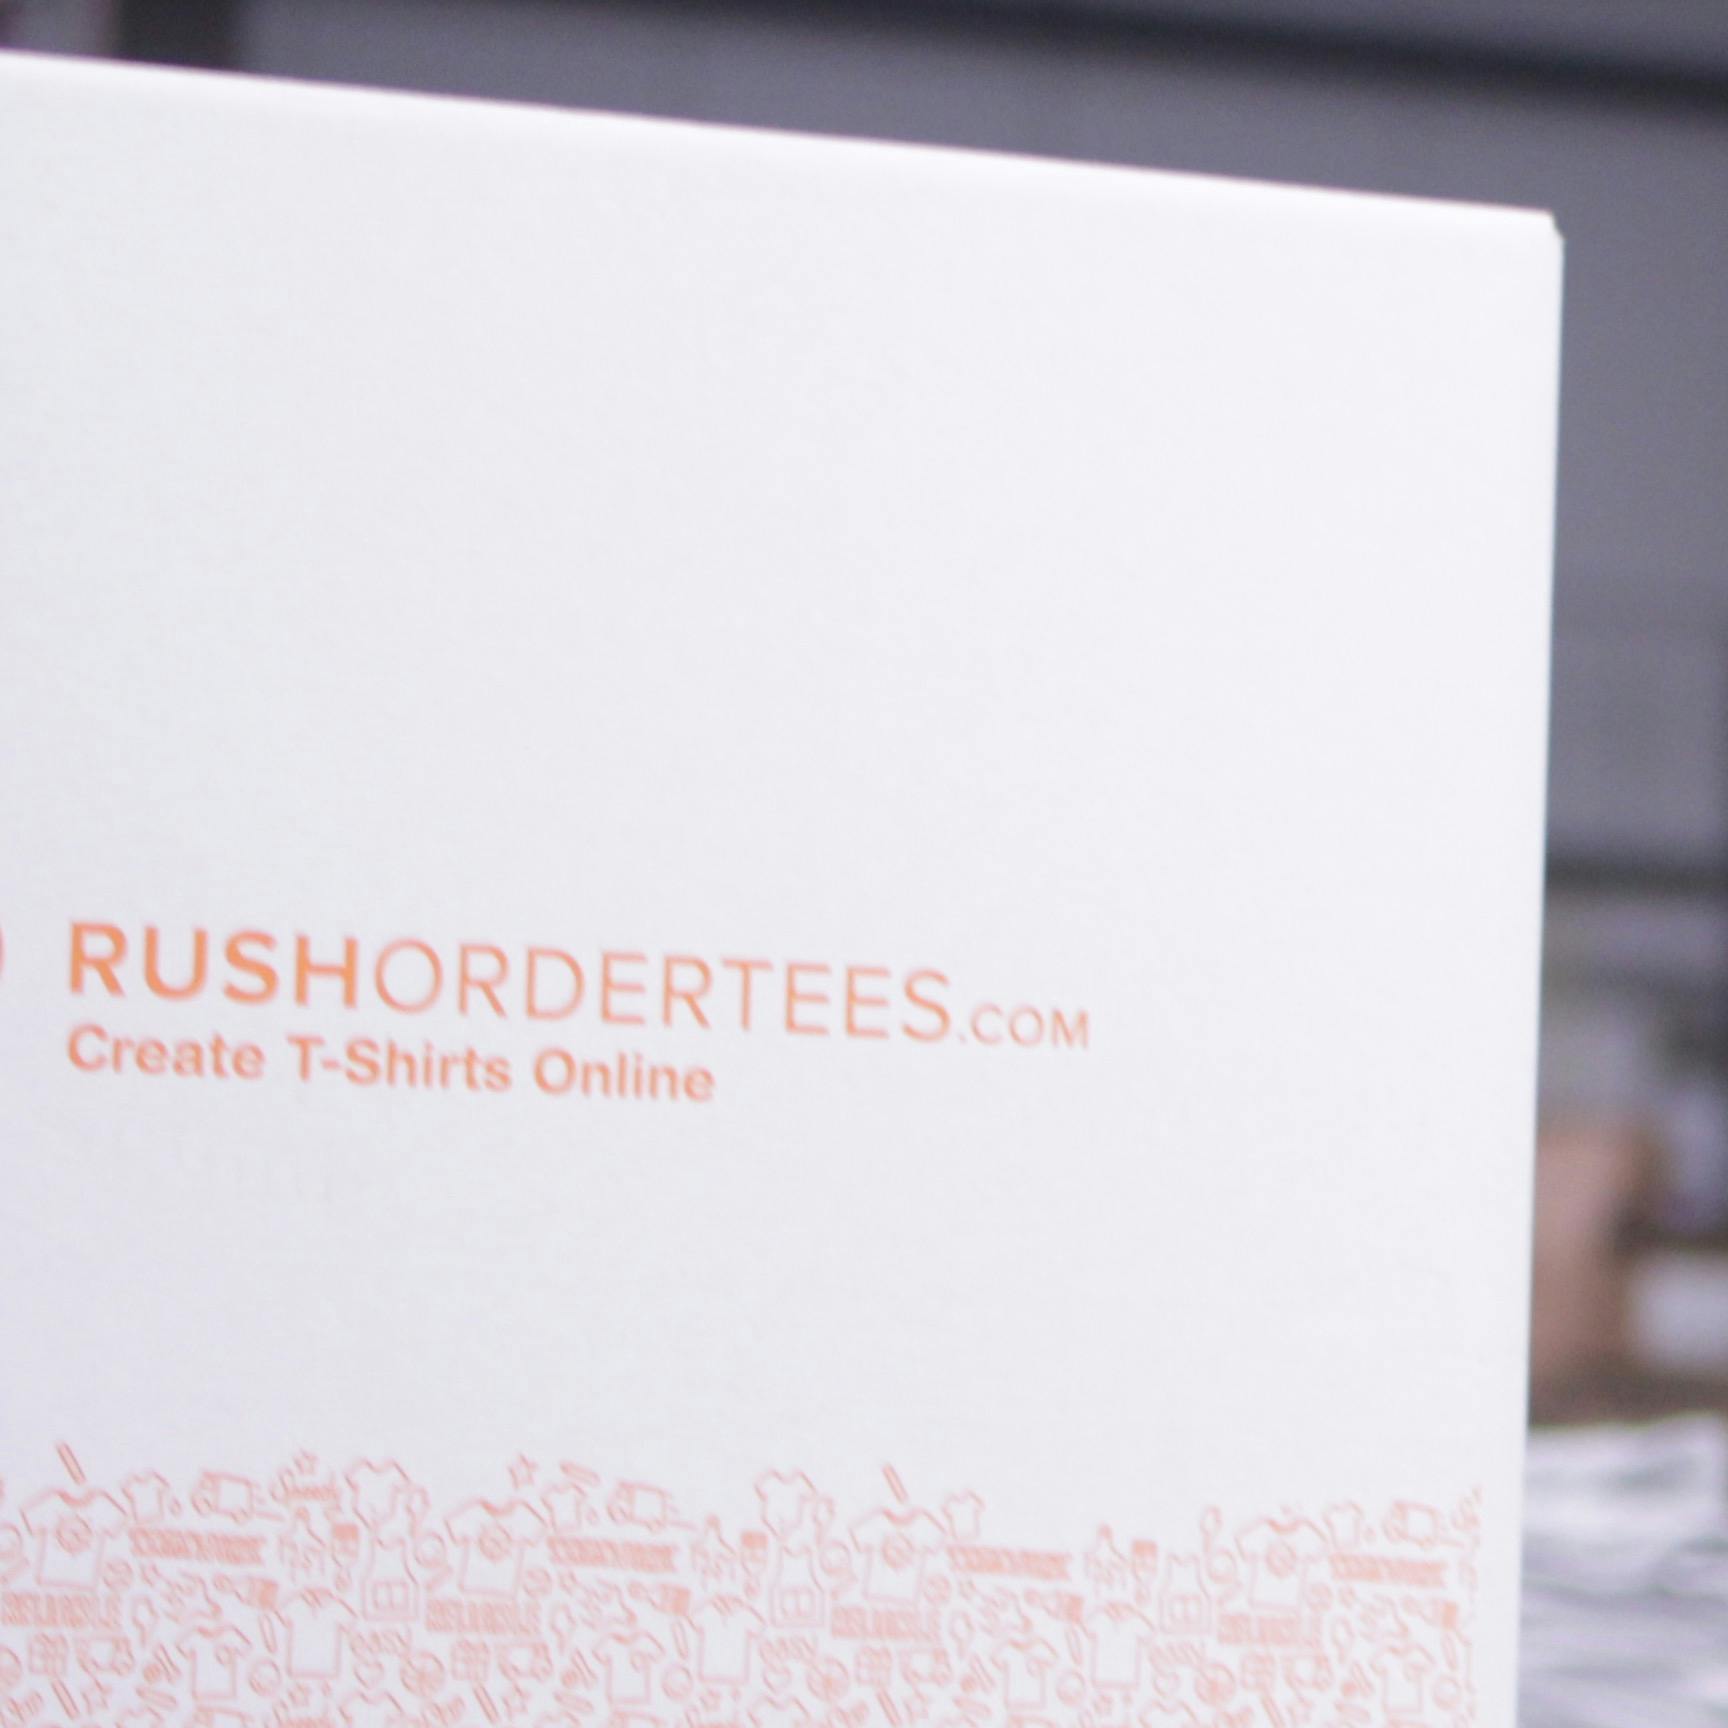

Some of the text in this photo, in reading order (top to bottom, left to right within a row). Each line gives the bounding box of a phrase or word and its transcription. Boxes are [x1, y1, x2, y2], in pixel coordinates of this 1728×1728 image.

[67, 919, 1090, 1047] RUSHORDERTEES.COM
[66, 1022, 717, 1103] Create T-Shirts Online
